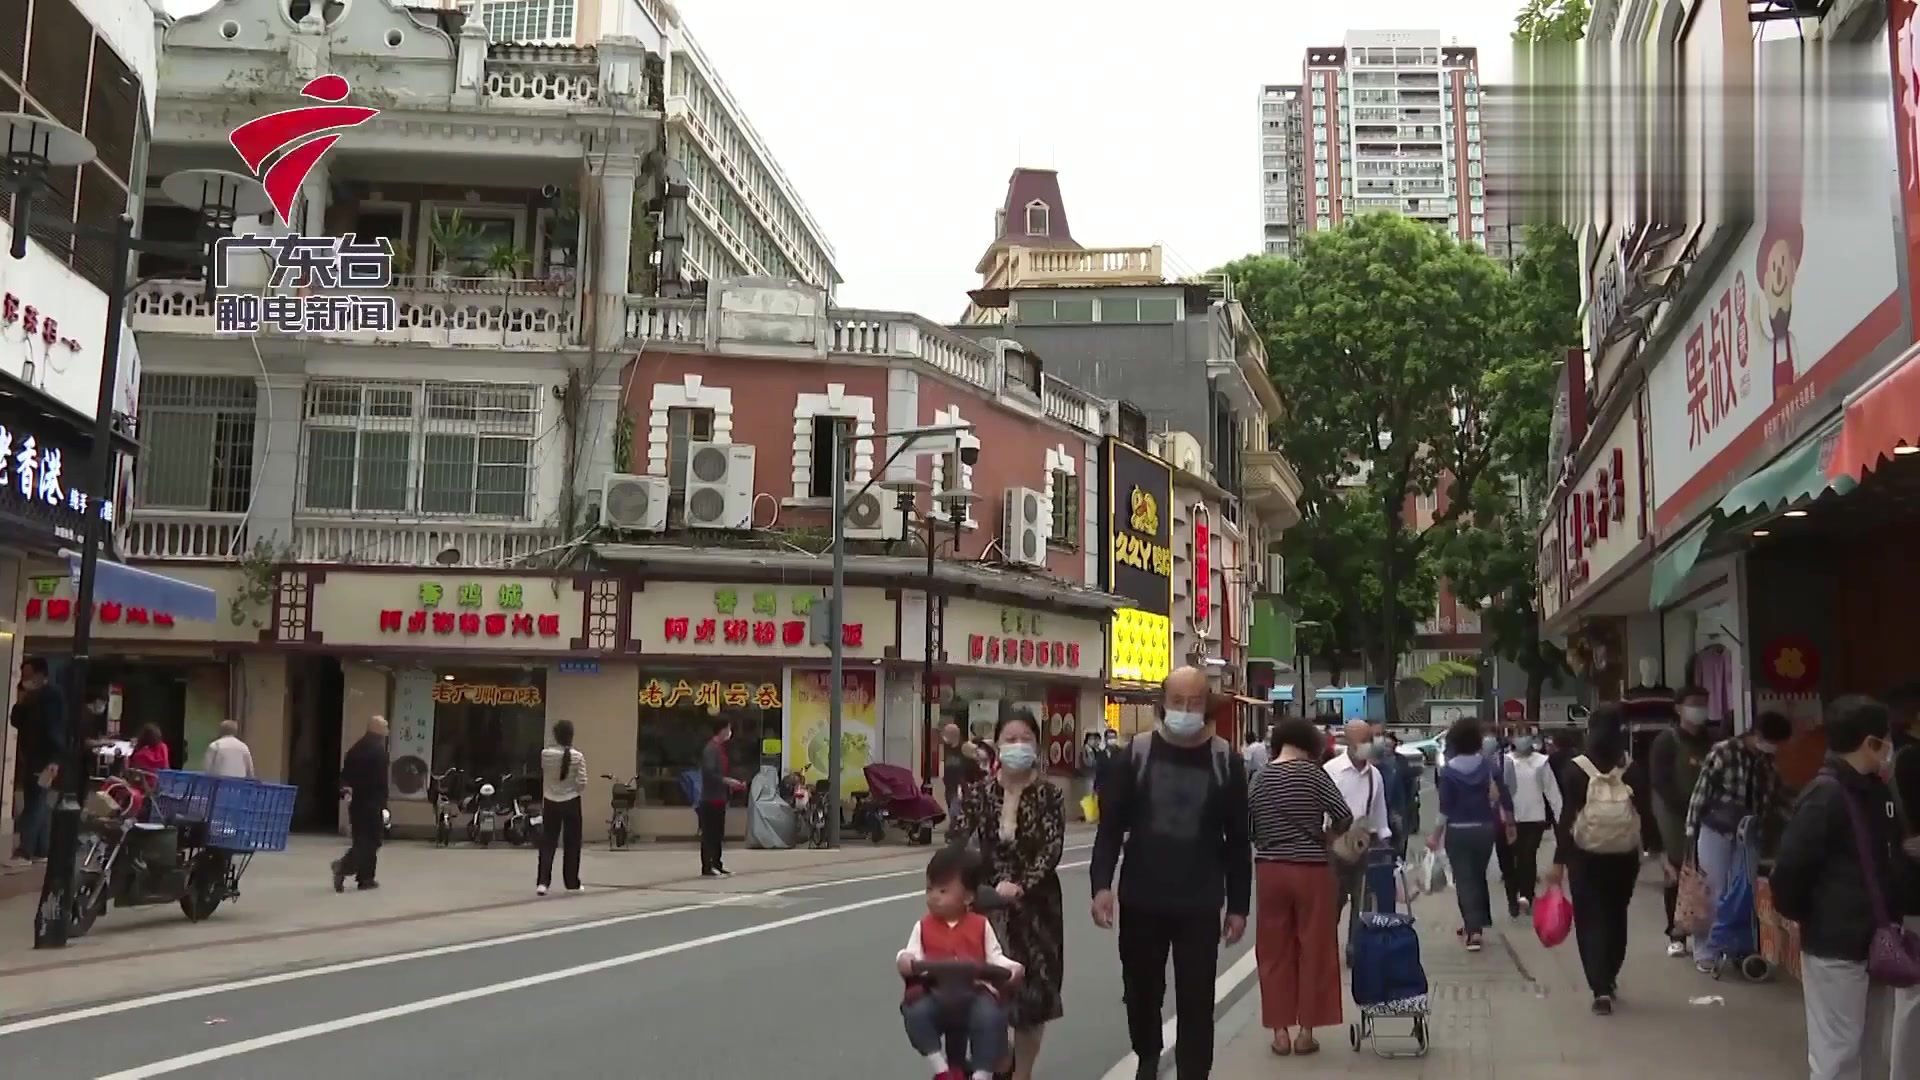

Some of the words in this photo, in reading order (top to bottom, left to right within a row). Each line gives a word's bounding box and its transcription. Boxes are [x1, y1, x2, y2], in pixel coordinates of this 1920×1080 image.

[1685, 288, 1737, 452] 果叔
[638, 680, 783, 711] 老广州云吞
